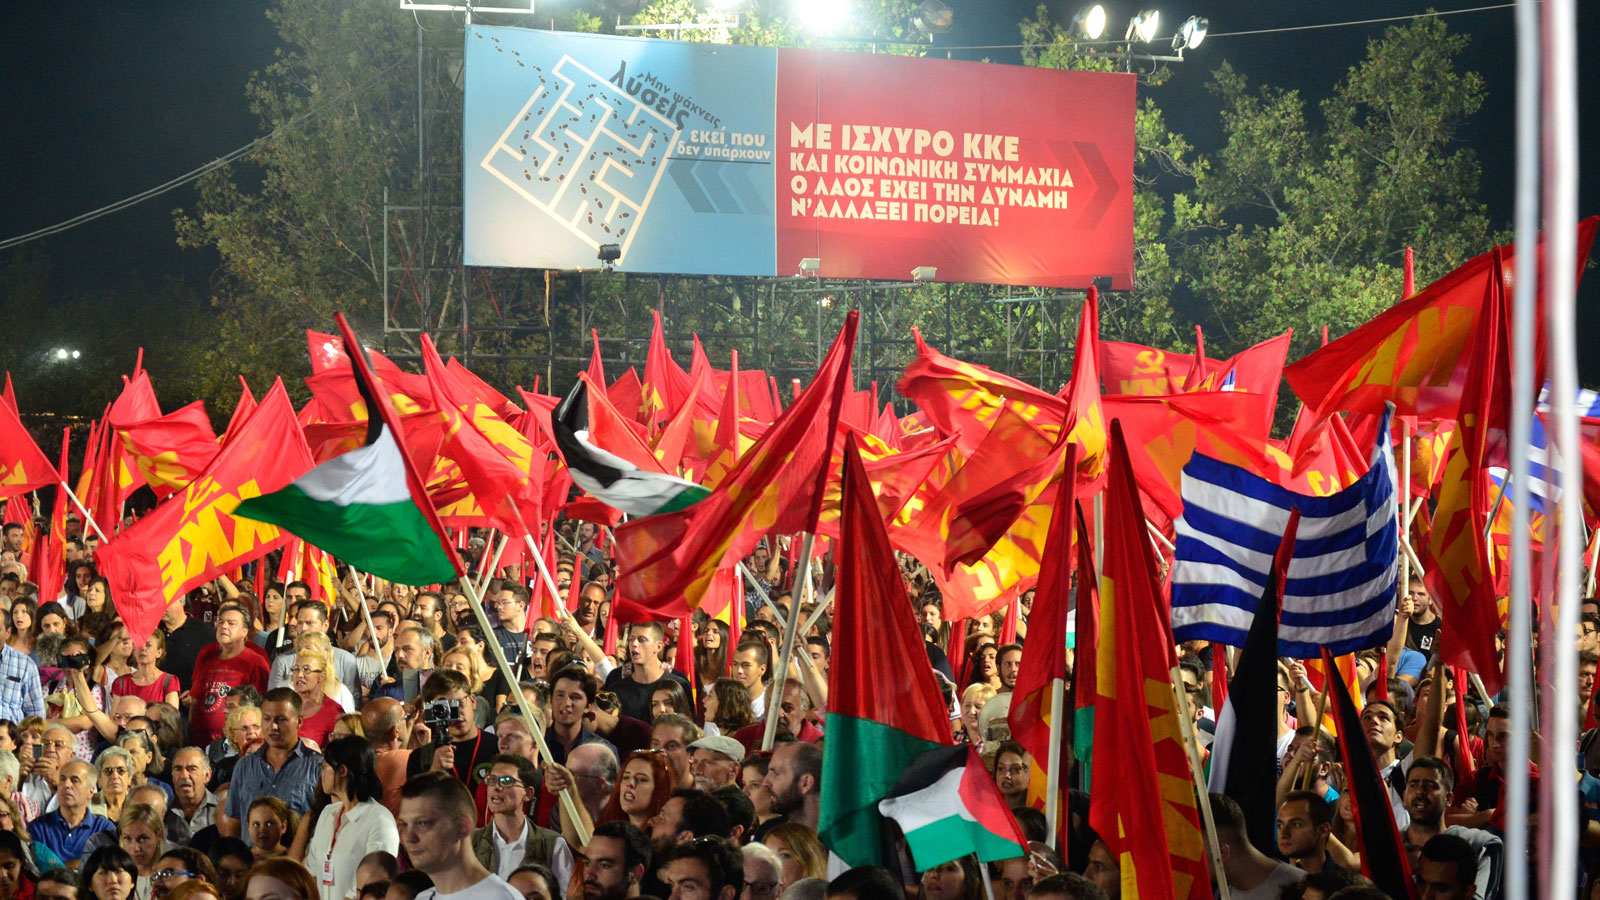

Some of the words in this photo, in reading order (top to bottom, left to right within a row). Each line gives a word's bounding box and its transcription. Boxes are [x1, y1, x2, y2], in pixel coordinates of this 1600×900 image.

[609, 60, 690, 131] λύσεις
[644, 71, 671, 95] Μην
[672, 92, 721, 129] ψάχνεις
[677, 141, 701, 156] δεν
[704, 144, 772, 162] υπάρχουν
[690, 126, 726, 145] εκεί
[731, 132, 765, 147] που
[790, 121, 832, 150] ΜΕ
[841, 124, 955, 157] ΙΣΧΥΡΟ
[963, 132, 1020, 162] ΚΚΕ
[790, 152, 828, 173] ΚΑΙ
[834, 154, 958, 180] ΚΟΙΝΩΝΙΚΗ
[963, 162, 1075, 188] ΣΥΜΜΑΧΙΑ
[790, 175, 808, 195] Ο
[813, 176, 875, 198] ΛΑΟΣ
[880, 179, 927, 200] ΕΧΕΙ
[932, 182, 975, 204] ΤΗΝ
[980, 185, 1068, 209] ΔΥΝΑΜΗ
[914, 203, 1000, 227] ΠΟΡΕΙΑ!
